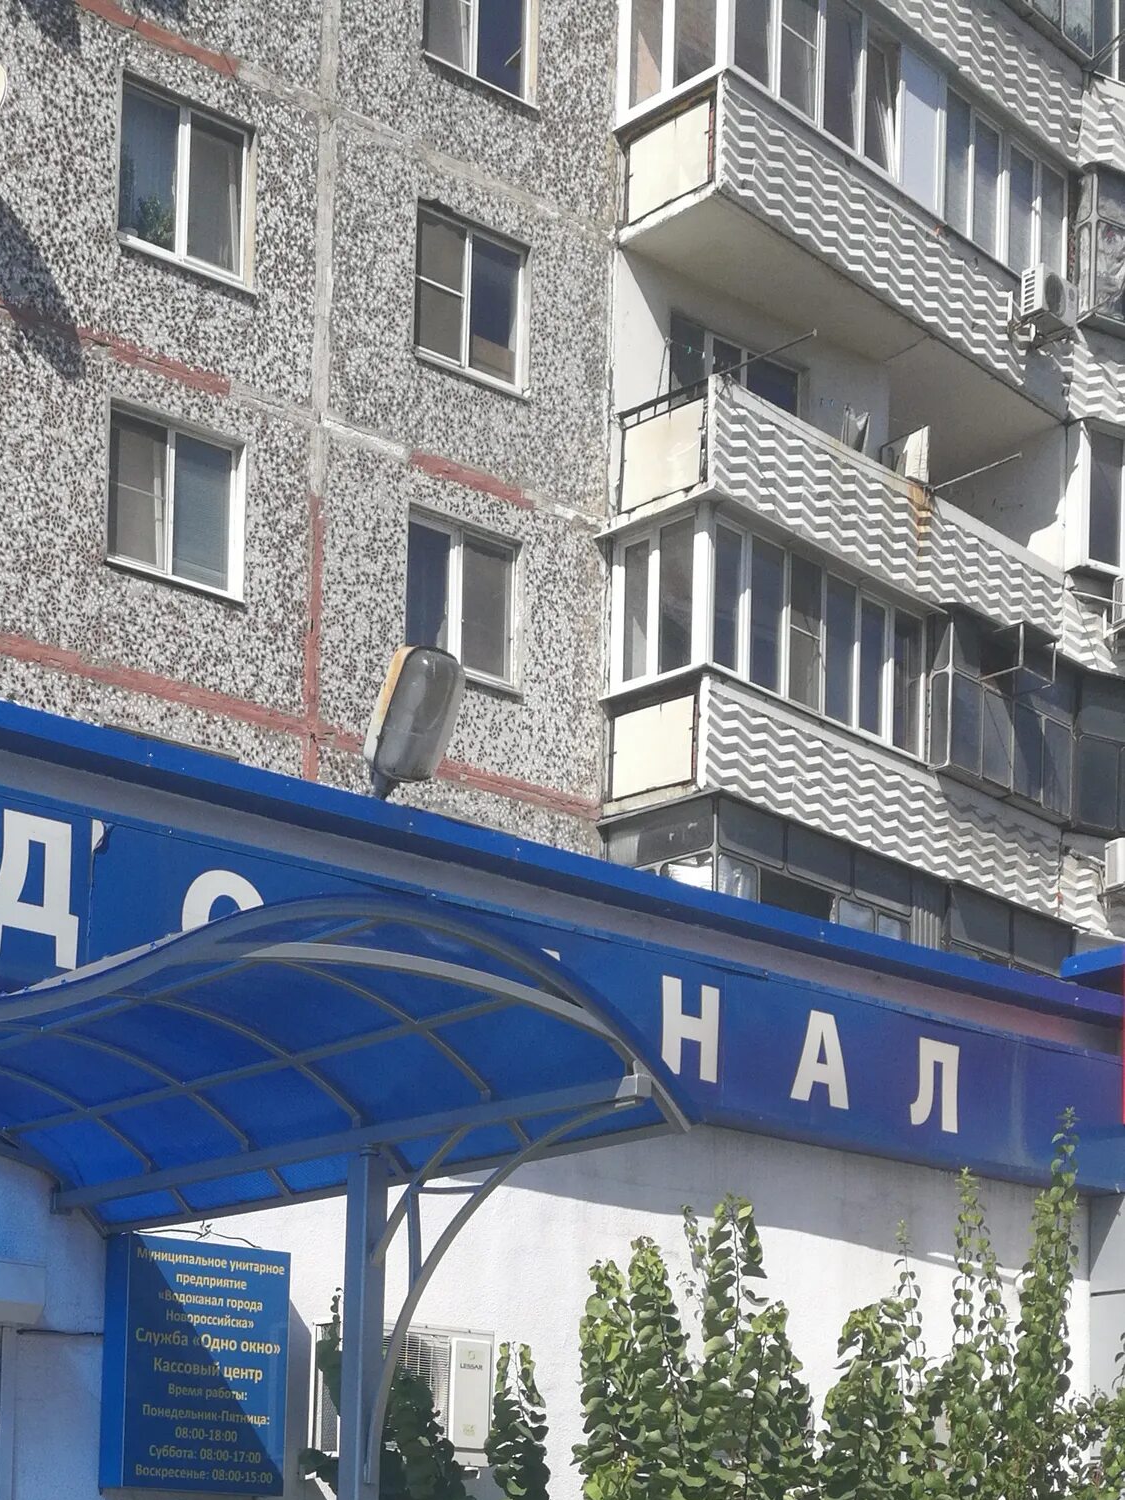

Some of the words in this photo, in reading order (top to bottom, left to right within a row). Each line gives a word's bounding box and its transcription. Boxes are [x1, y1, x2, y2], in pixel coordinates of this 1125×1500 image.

[137, 1247, 227, 1269] Муниципальное
[229, 1260, 285, 1276] унитарное
[176, 1273, 247, 1290] предприятие
[158, 1290, 224, 1308] «Водоканал
[226, 1298, 263, 1313] города
[166, 1310, 254, 1329] Новороссийска»
[135, 1328, 188, 1347] Служба
[192, 1333, 237, 1354] «Одно
[241, 1340, 281, 1355] окно»
[153, 1357, 220, 1376] Кассовый
[224, 1365, 263, 1383] центр
[168, 1383, 202, 1398] Время
[206, 1387, 248, 1401] работы:
[142, 1404, 270, 1426] Понедельник-Пятница:
[175, 1426, 237, 1442] 08:00-18:00
[149, 1445, 197, 1460] Суббота:
[199, 1449, 261, 1464] 08:00-17:00
[135, 1464, 210, 1481] Воскресенье:
